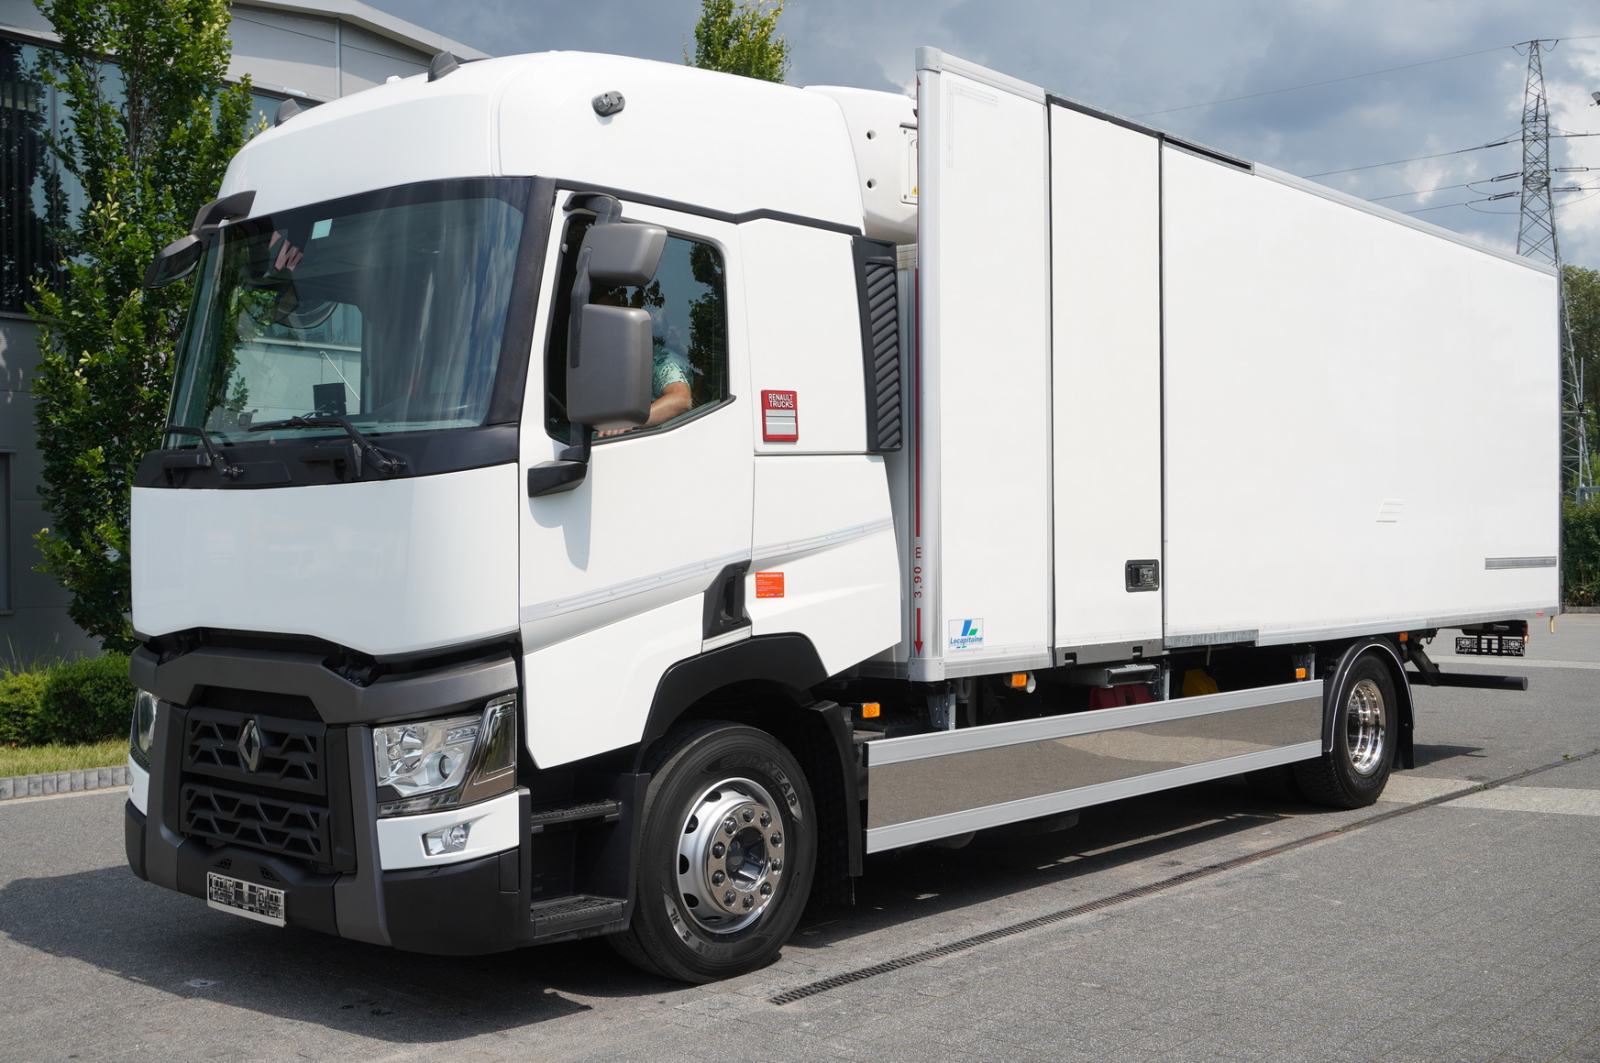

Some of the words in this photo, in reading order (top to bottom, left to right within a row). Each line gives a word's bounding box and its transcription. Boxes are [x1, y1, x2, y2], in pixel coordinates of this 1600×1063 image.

[768, 393, 793, 402] RENAULT
[769, 400, 794, 409] TRUCKS
[915, 546, 922, 559] m
